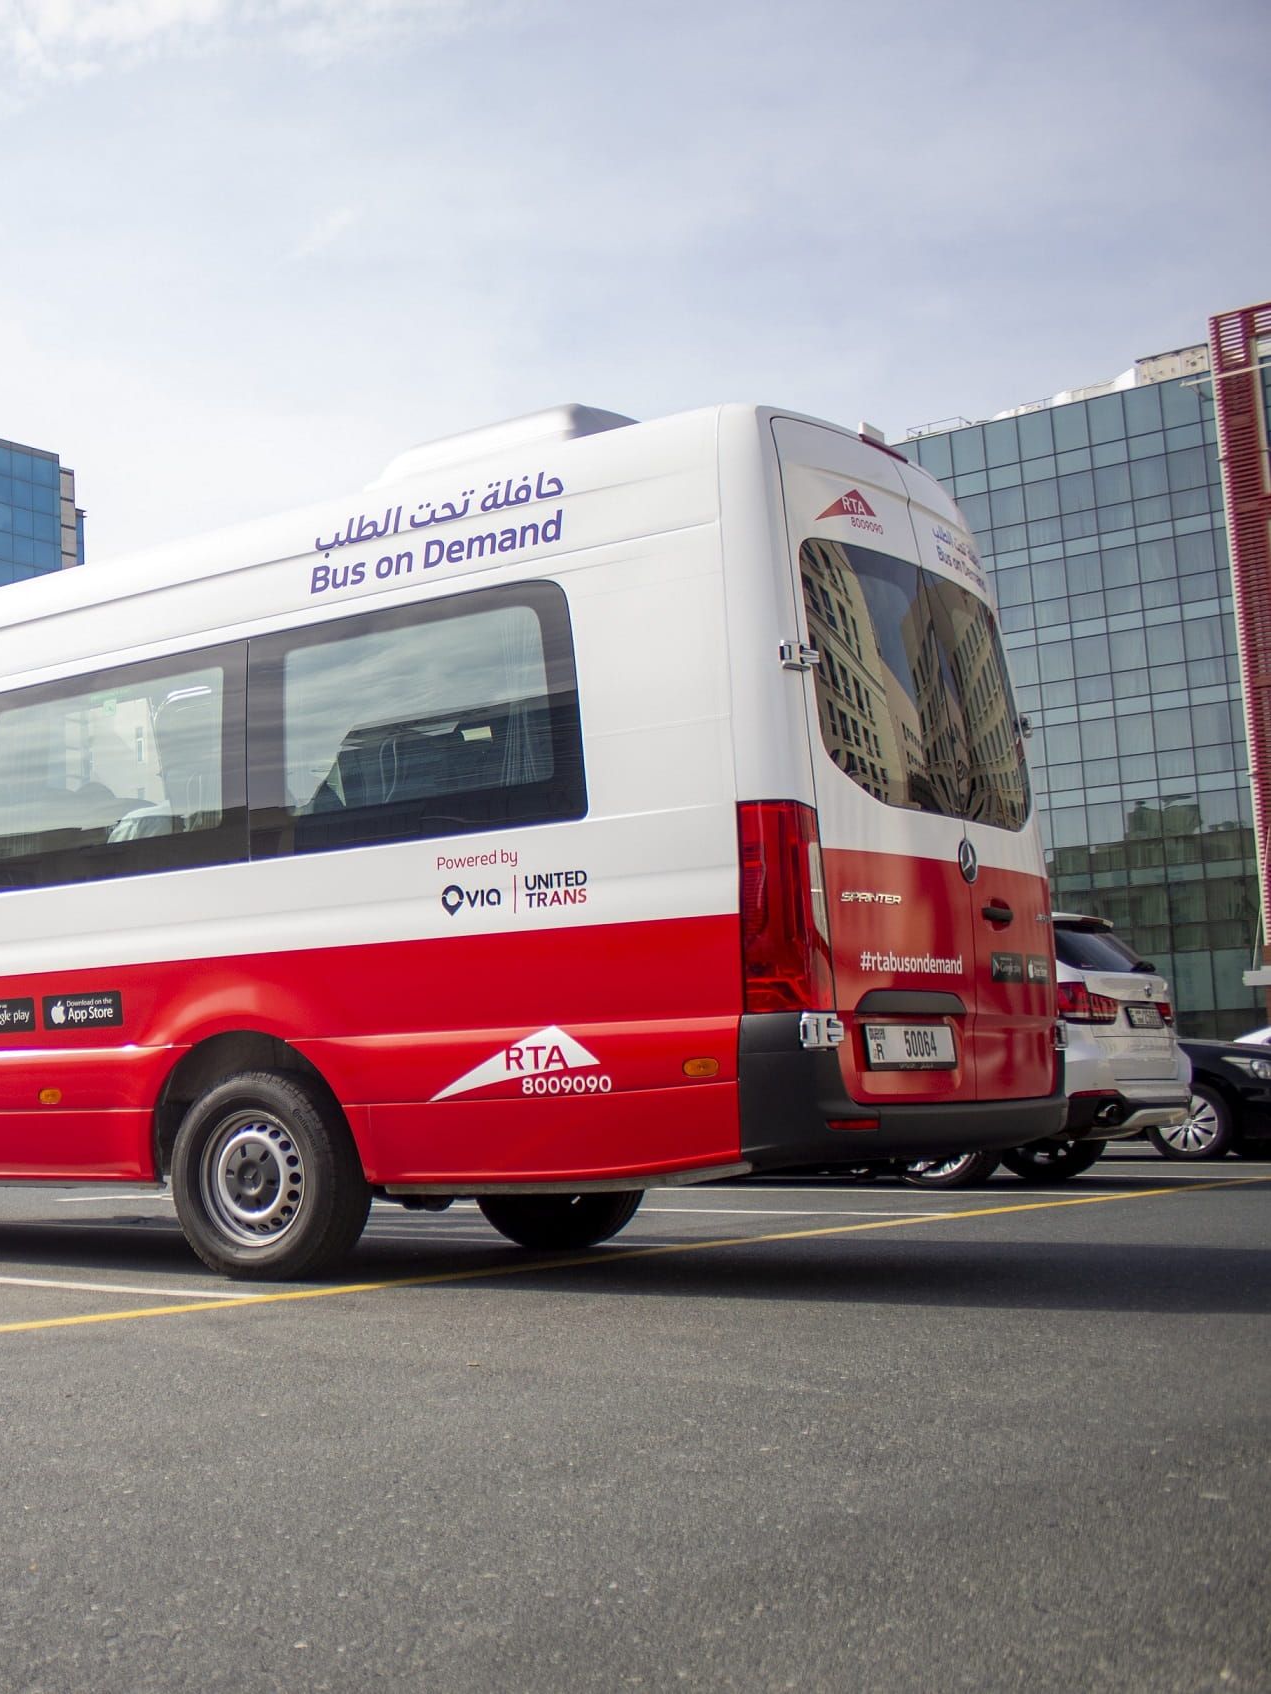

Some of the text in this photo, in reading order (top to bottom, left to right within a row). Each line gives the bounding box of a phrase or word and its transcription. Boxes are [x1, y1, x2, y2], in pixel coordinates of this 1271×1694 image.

[315, 471, 564, 559] حافلة تحت الطلب
[842, 496, 867, 515] RTA
[310, 509, 563, 594] Bus on Demand
[936, 545, 952, 567] Bus
[436, 849, 518, 870] Powered by
[524, 870, 588, 890] UNITED
[525, 888, 587, 908] TRANS
[841, 891, 901, 905] SPRINTER
[860, 951, 963, 974] #rtabusondemand
[13, 1010, 30, 1024] play
[67, 1006, 113, 1023] App Store
[876, 1043, 884, 1060] R
[904, 1030, 937, 1057] 50064
[505, 1045, 570, 1071] RTA
[522, 1075, 612, 1094] 8009090
